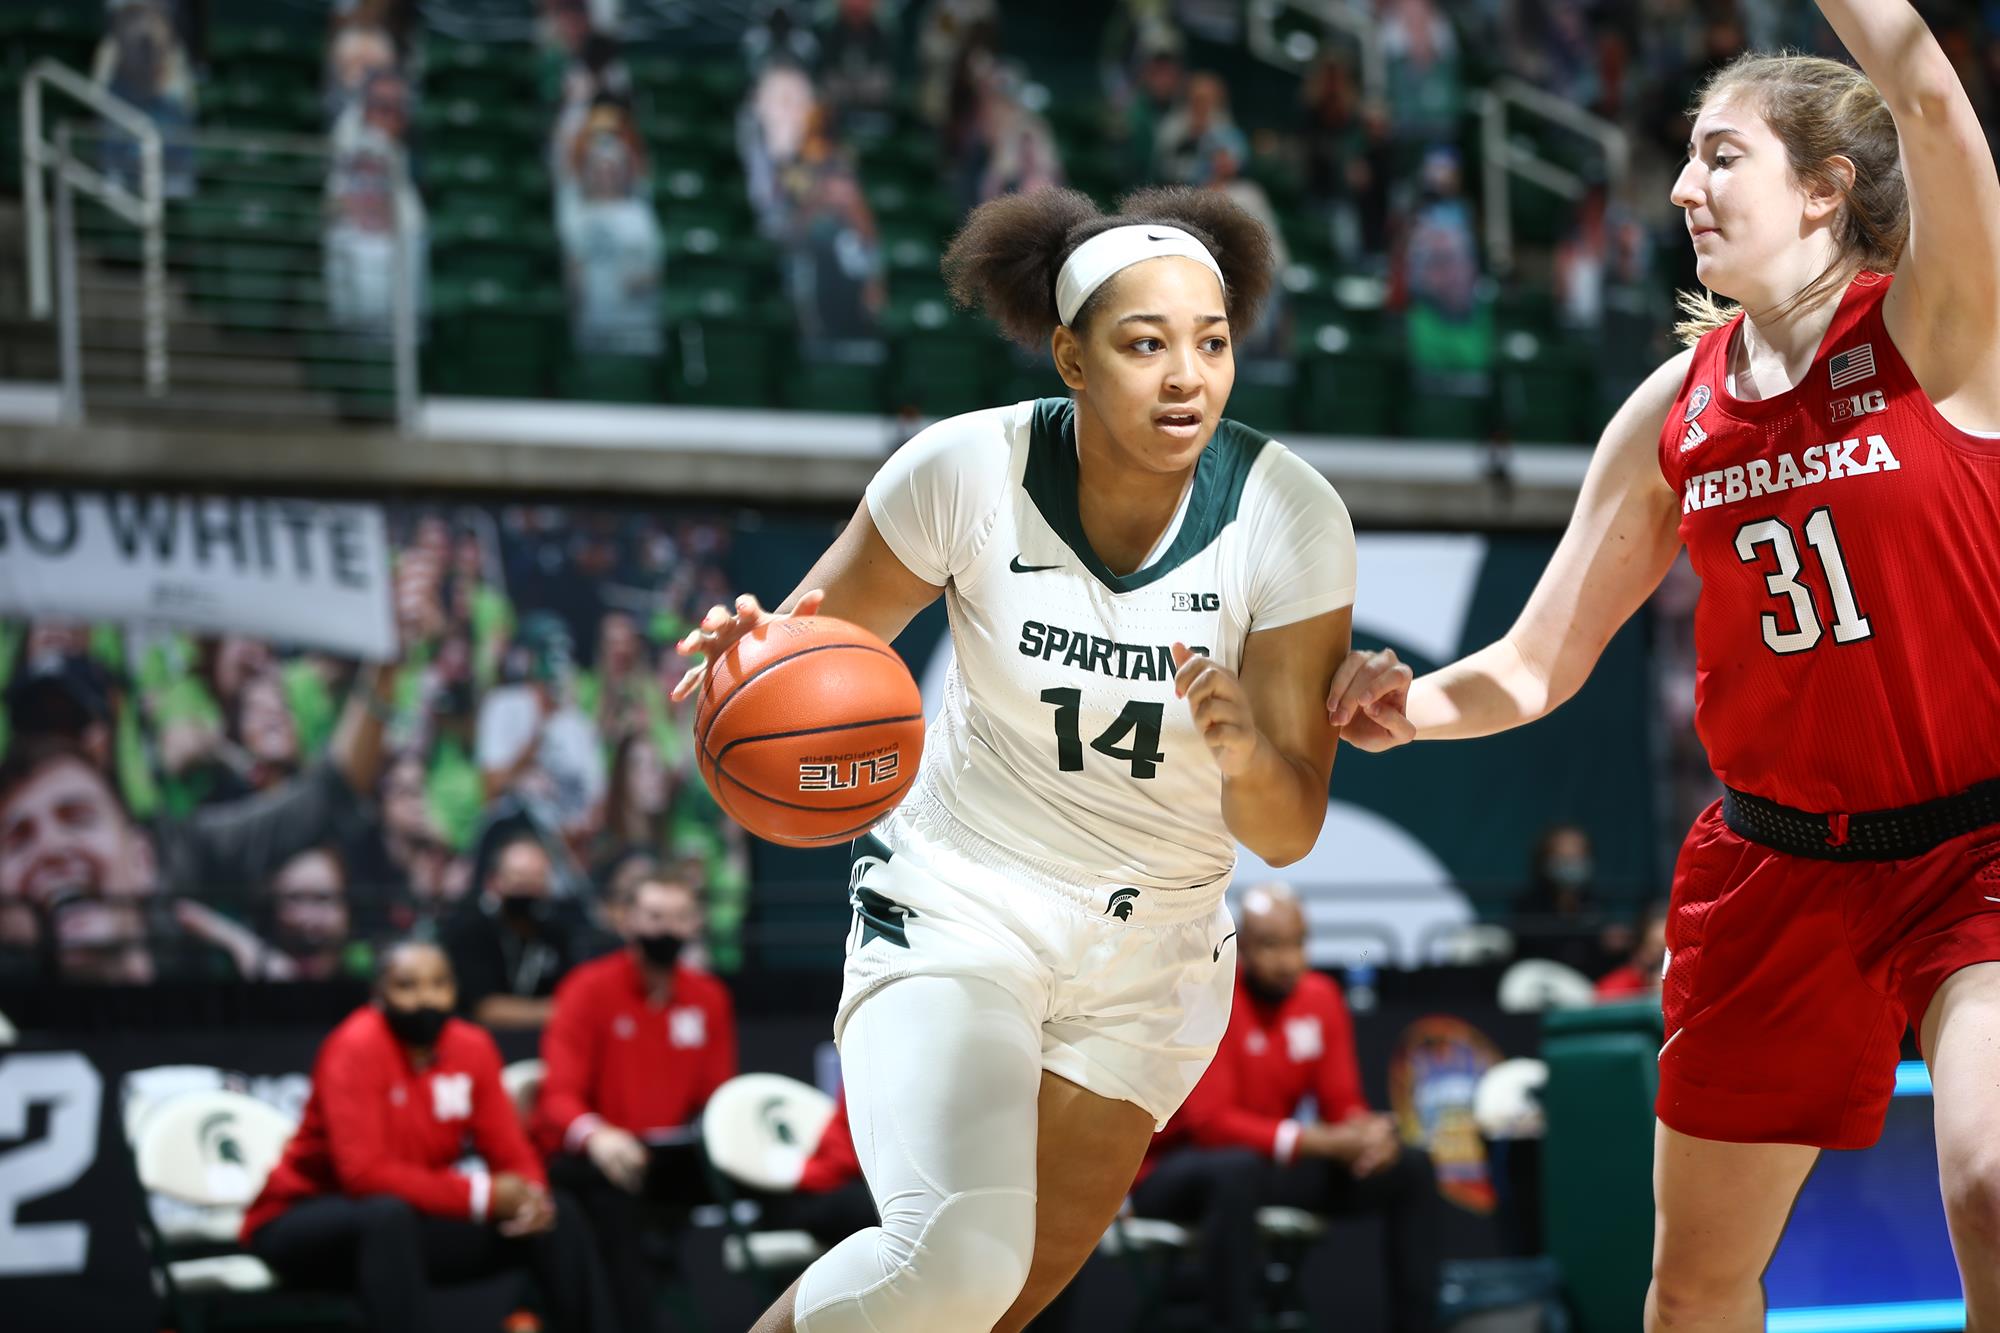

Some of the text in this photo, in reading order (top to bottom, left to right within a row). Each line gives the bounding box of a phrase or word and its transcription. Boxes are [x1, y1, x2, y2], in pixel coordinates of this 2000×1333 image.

[1683, 434, 1900, 515] NEBRASKA
[0, 490, 373, 594] O WHITE
[1732, 504, 1875, 656] 31
[799, 742, 899, 763] CHAMPIONSHIP
[799, 751, 899, 791] ELITE
[1040, 686, 1165, 779] 14
